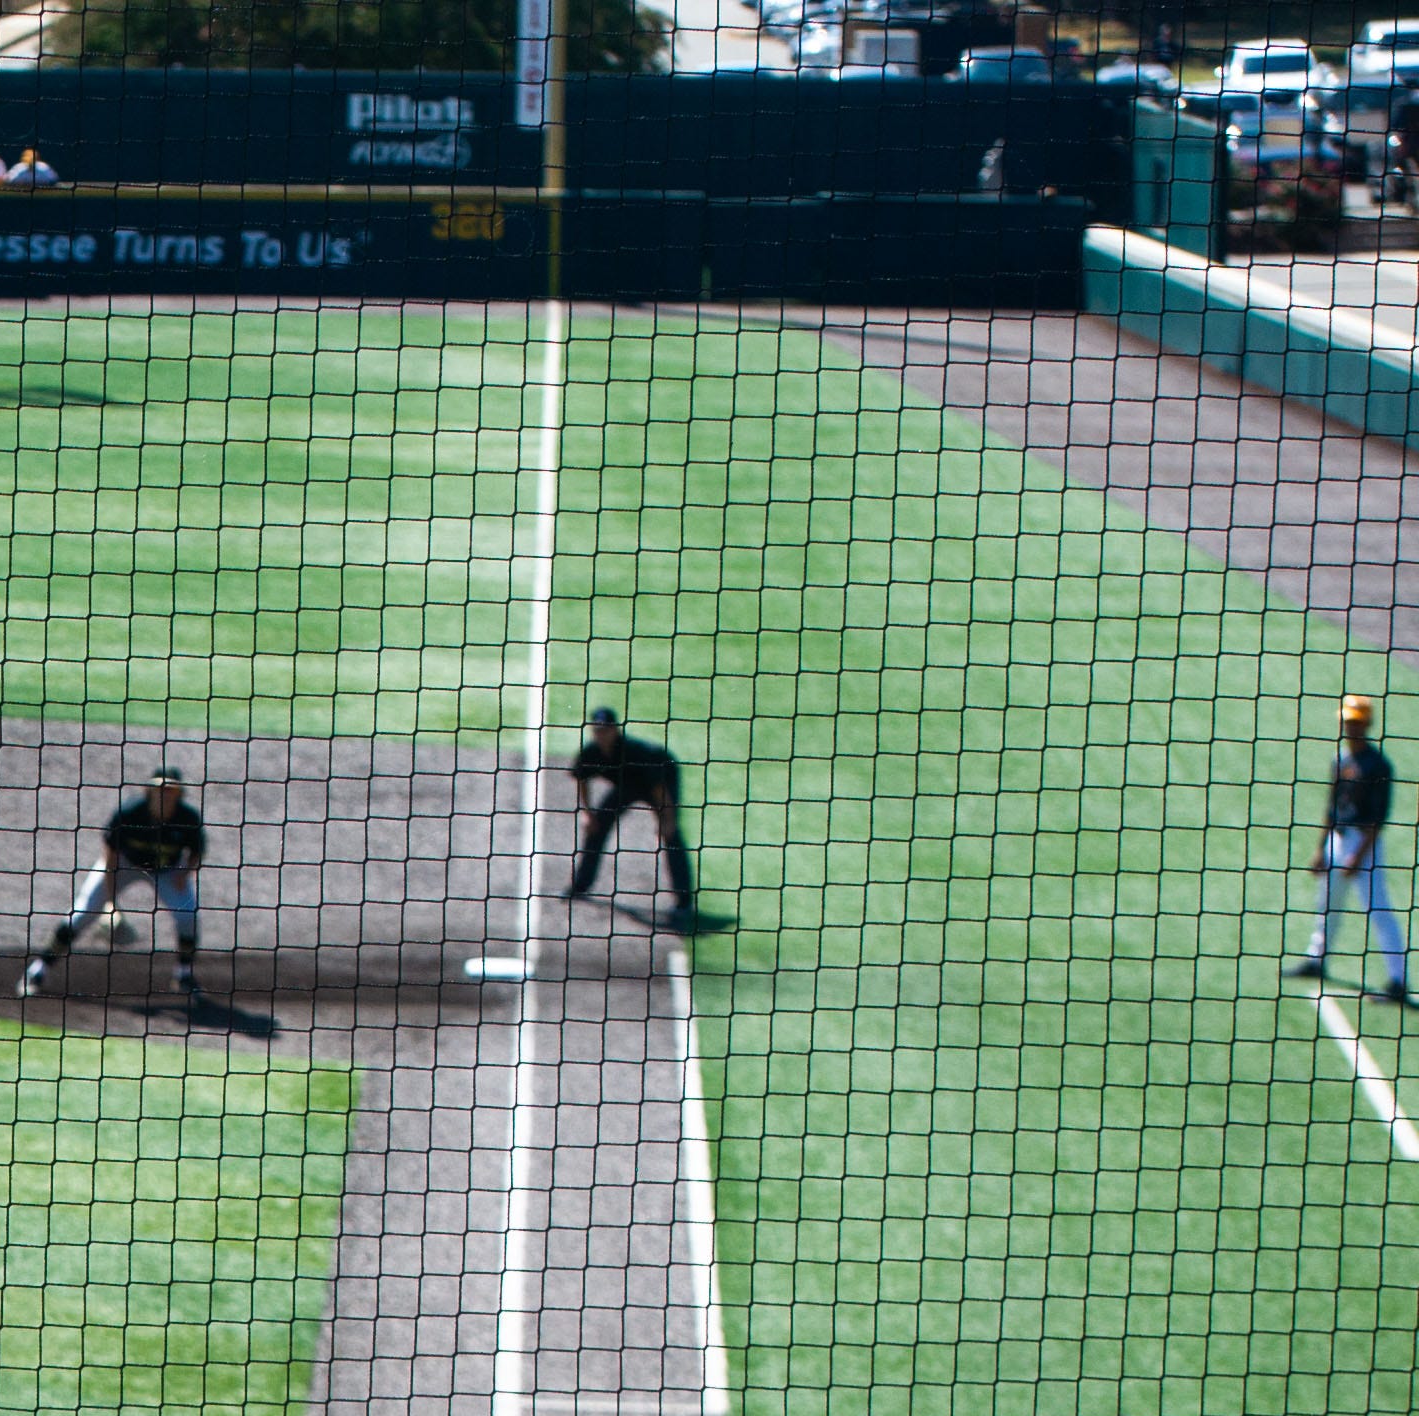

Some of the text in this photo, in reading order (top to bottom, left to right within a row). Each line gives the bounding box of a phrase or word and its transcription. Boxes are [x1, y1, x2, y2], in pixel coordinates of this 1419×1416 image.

[113, 228, 223, 265] Turns
[242, 230, 283, 267] To
[295, 231, 353, 267] Us
